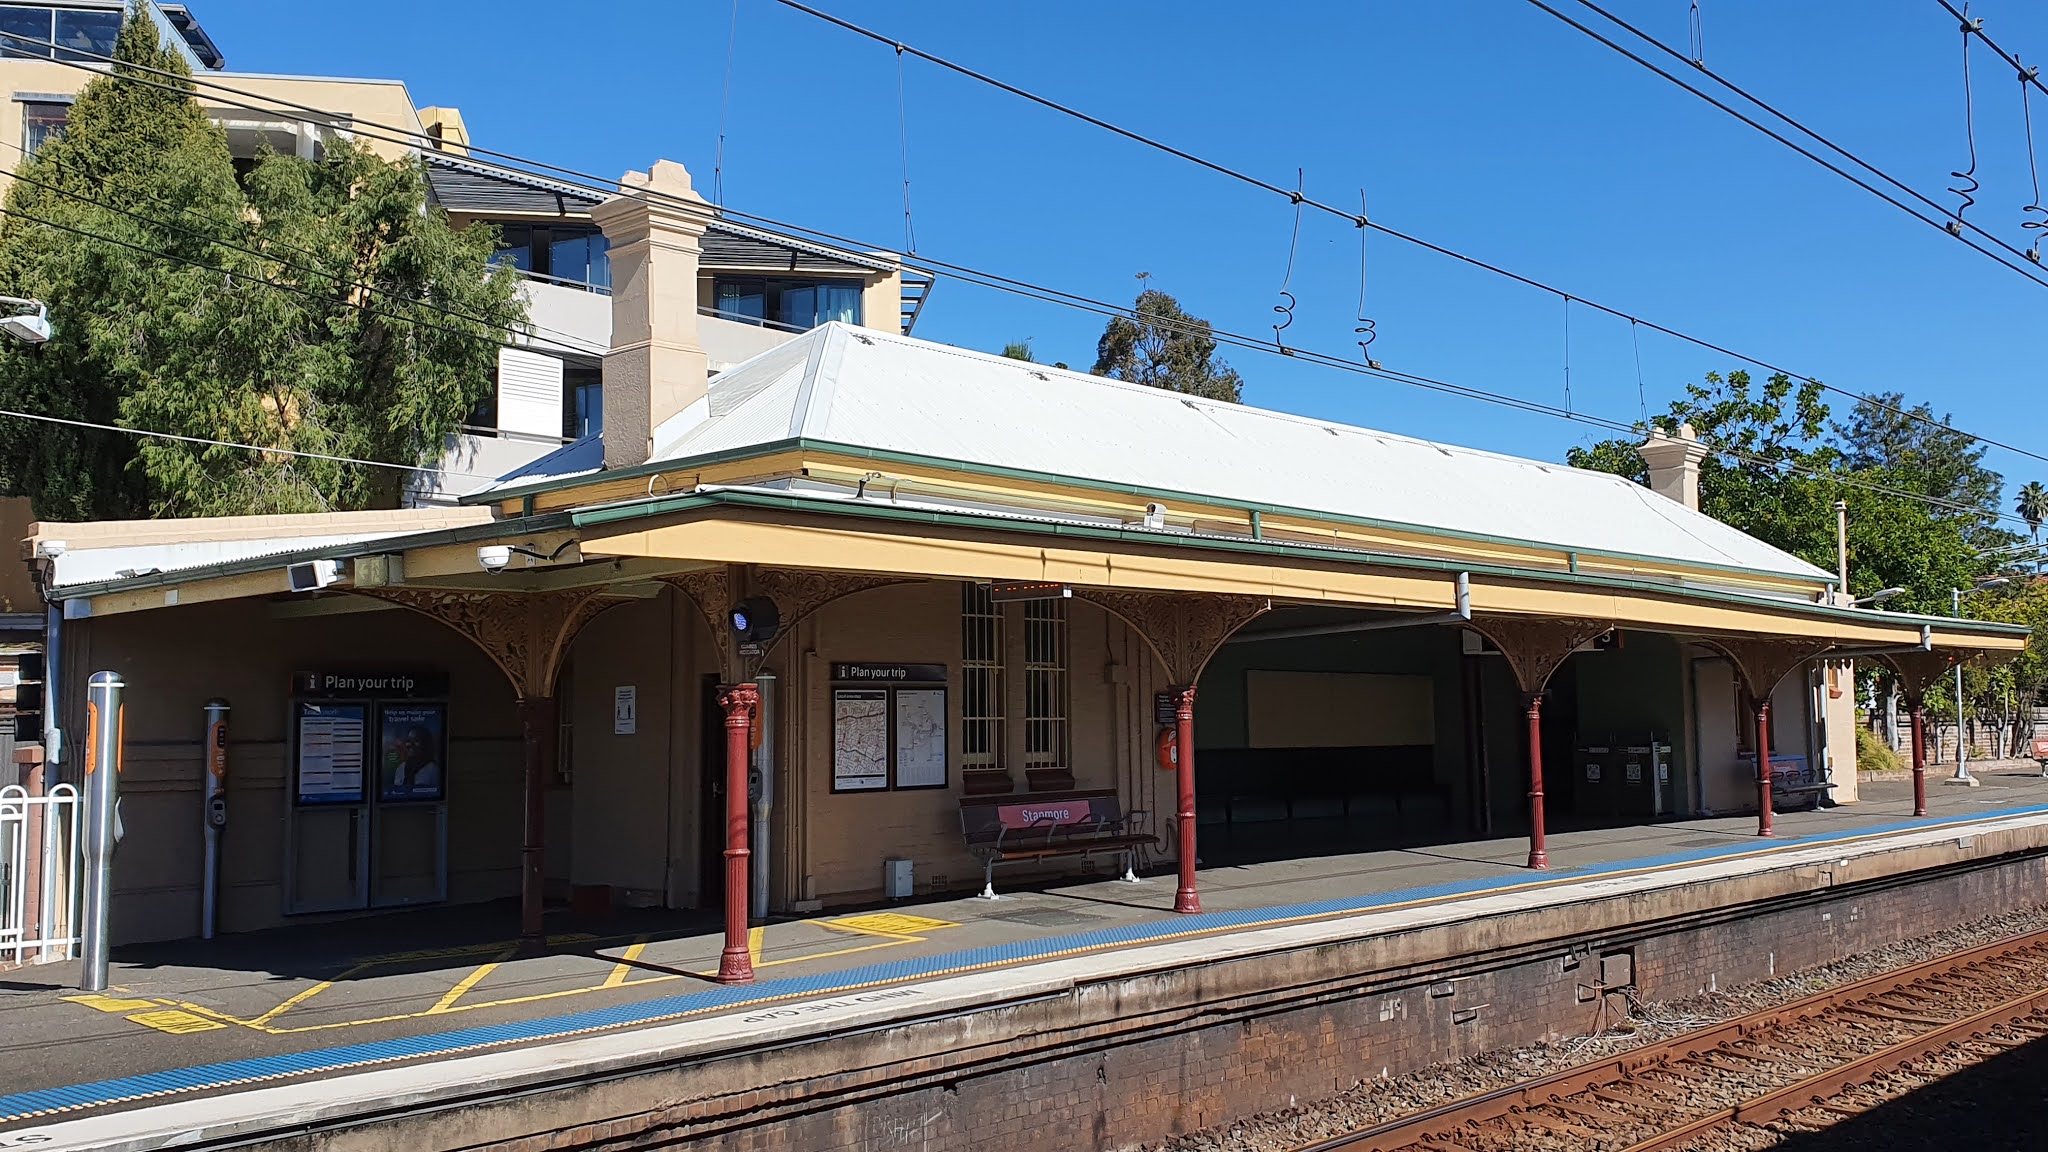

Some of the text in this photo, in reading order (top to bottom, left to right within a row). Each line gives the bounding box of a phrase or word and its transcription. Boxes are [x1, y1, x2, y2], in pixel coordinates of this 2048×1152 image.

[851, 666, 870, 678] Plan
[871, 669, 890, 680] your
[891, 667, 906, 680] trip
[325, 675, 355, 689] Plan
[357, 678, 389, 692] your
[391, 675, 414, 692] trip
[1022, 809, 1069, 822] Stanmore
[744, 989, 923, 1023] MIND THE GAP
